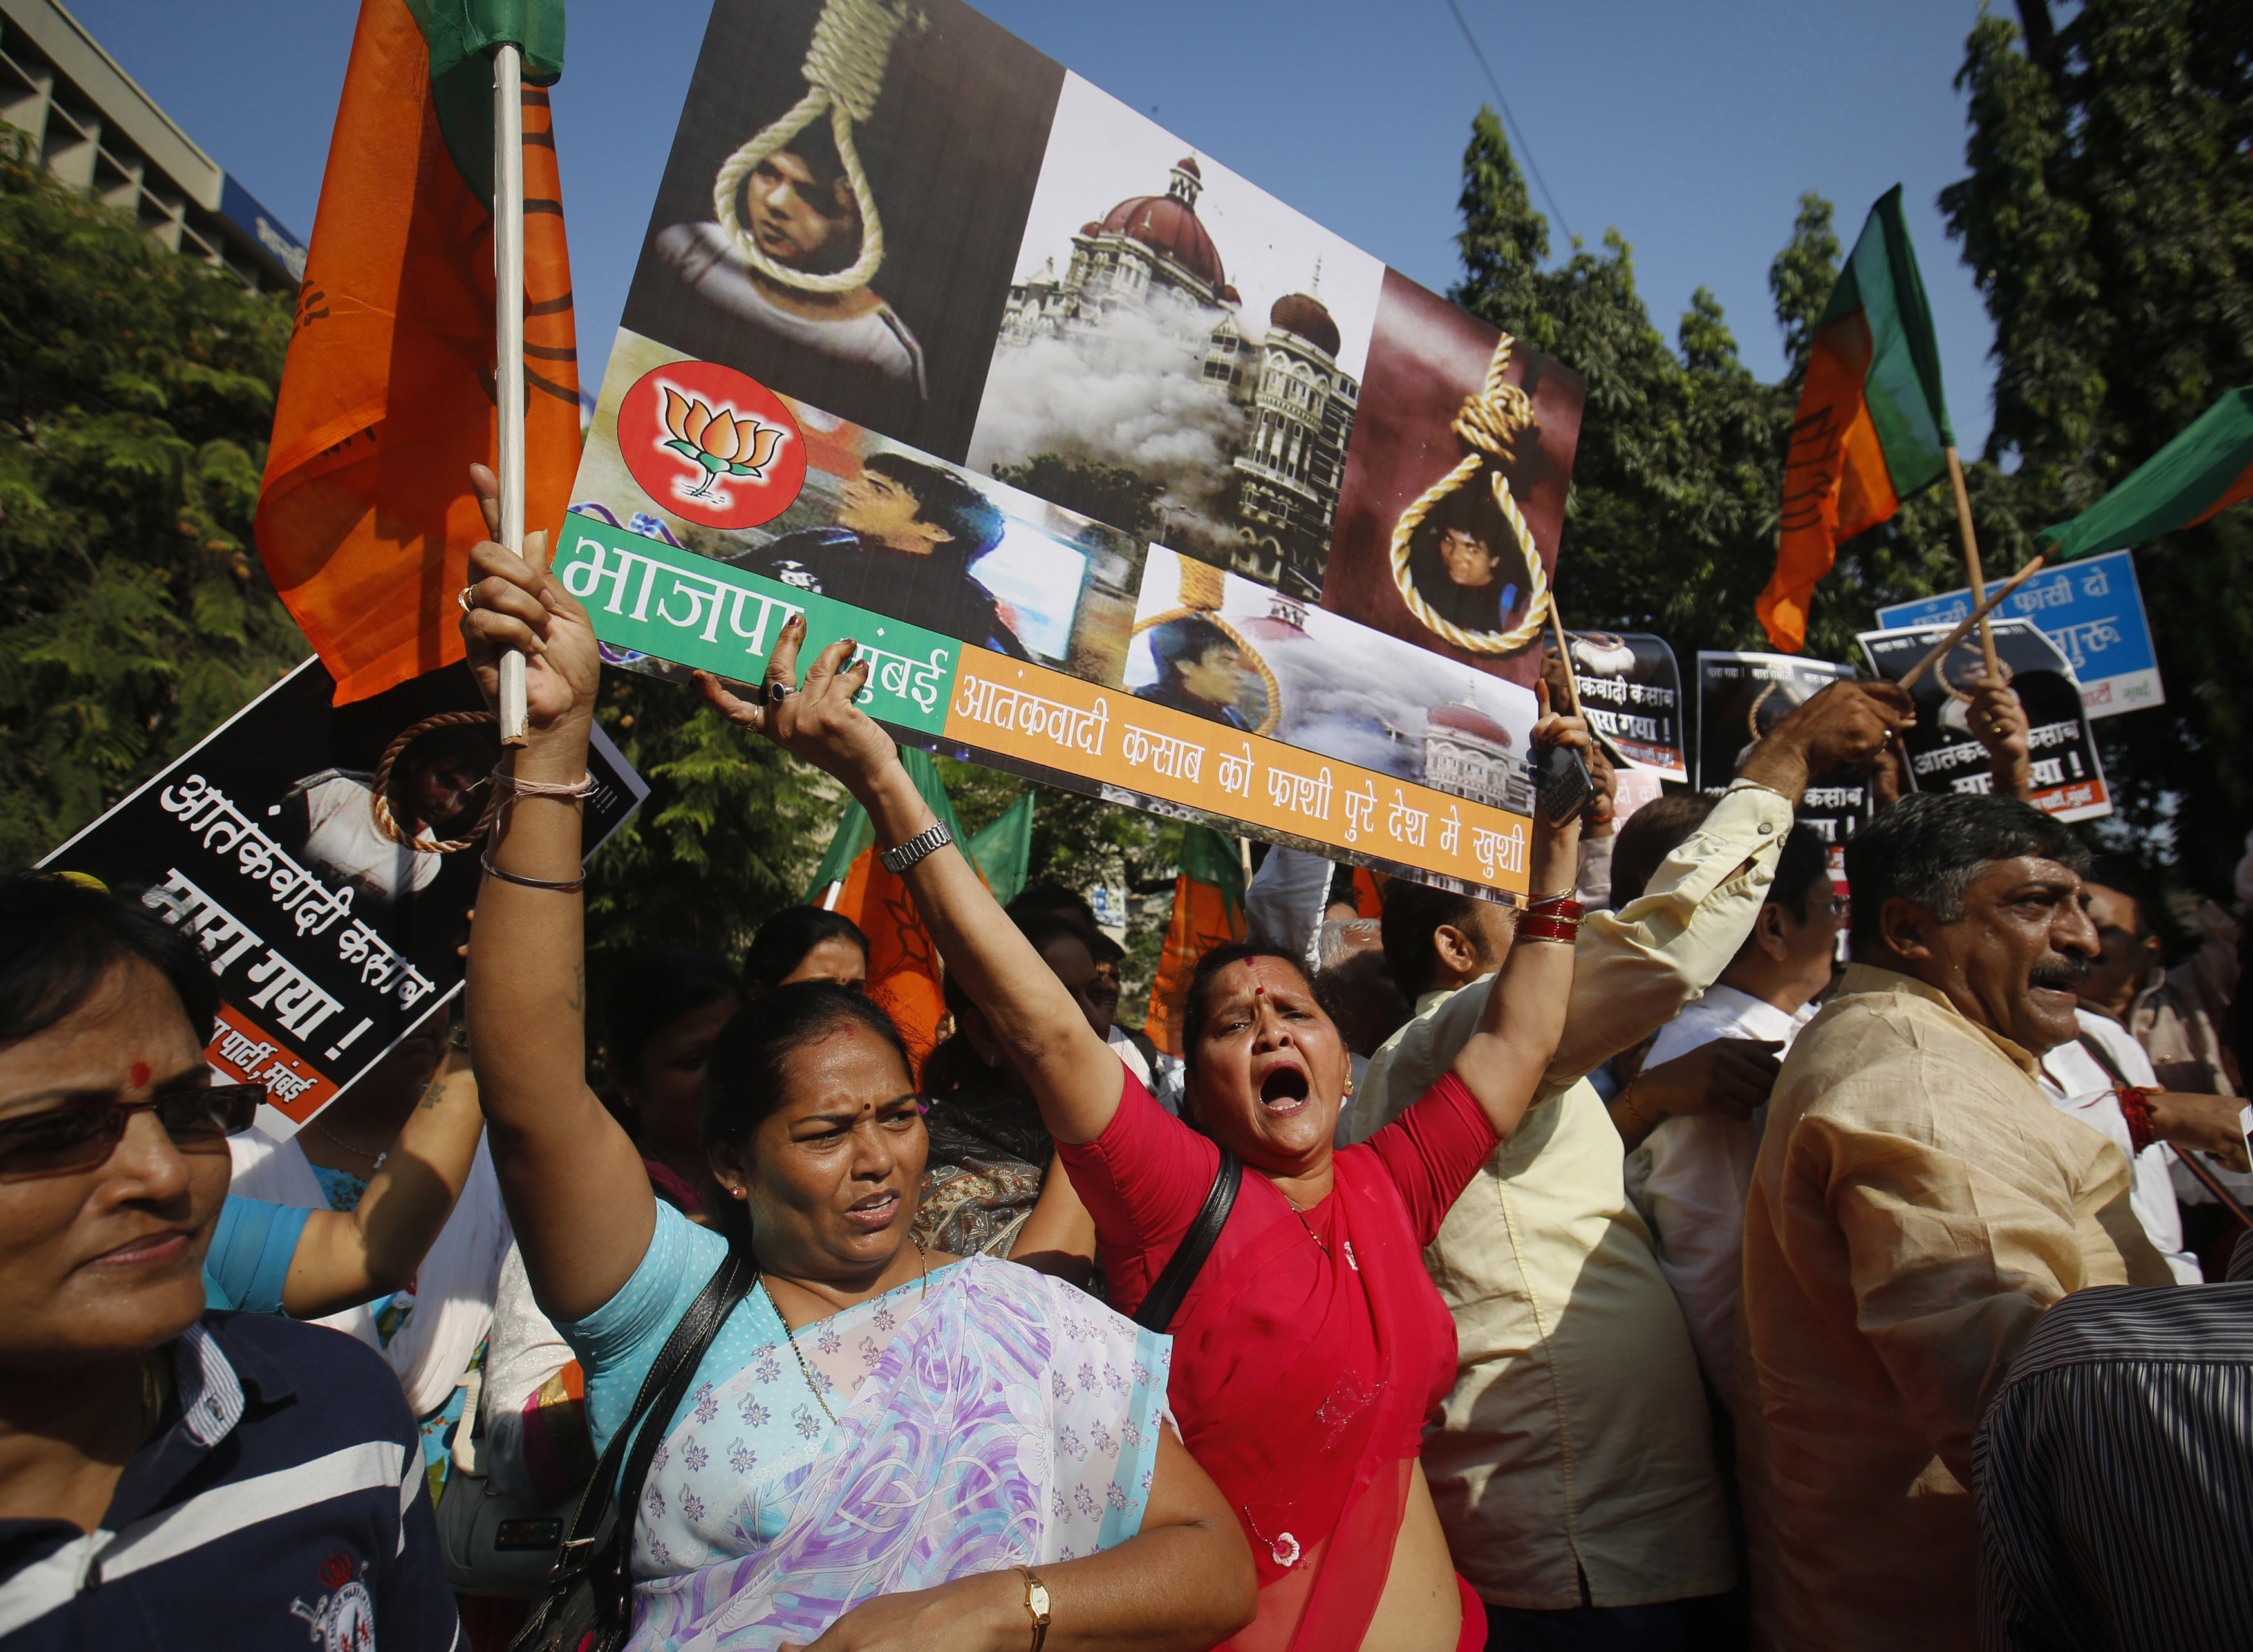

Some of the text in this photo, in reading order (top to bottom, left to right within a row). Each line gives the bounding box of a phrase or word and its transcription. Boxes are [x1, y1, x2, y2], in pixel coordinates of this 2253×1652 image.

[2082, 566, 2110, 598] दो
[1629, 684, 1674, 708] कसाब
[1618, 713, 1657, 741] गया
[1663, 717, 1671, 742] !
[955, 669, 1525, 879] आतंकवादी कसाब को फाशी पुरे देश मे खुशी
[2068, 750, 2084, 778] !
[1804, 787, 1864, 809] कसाब
[160, 774, 436, 1011] आतंकवादी कसाब
[248, 948, 345, 1041] गया
[324, 1017, 375, 1061] !
